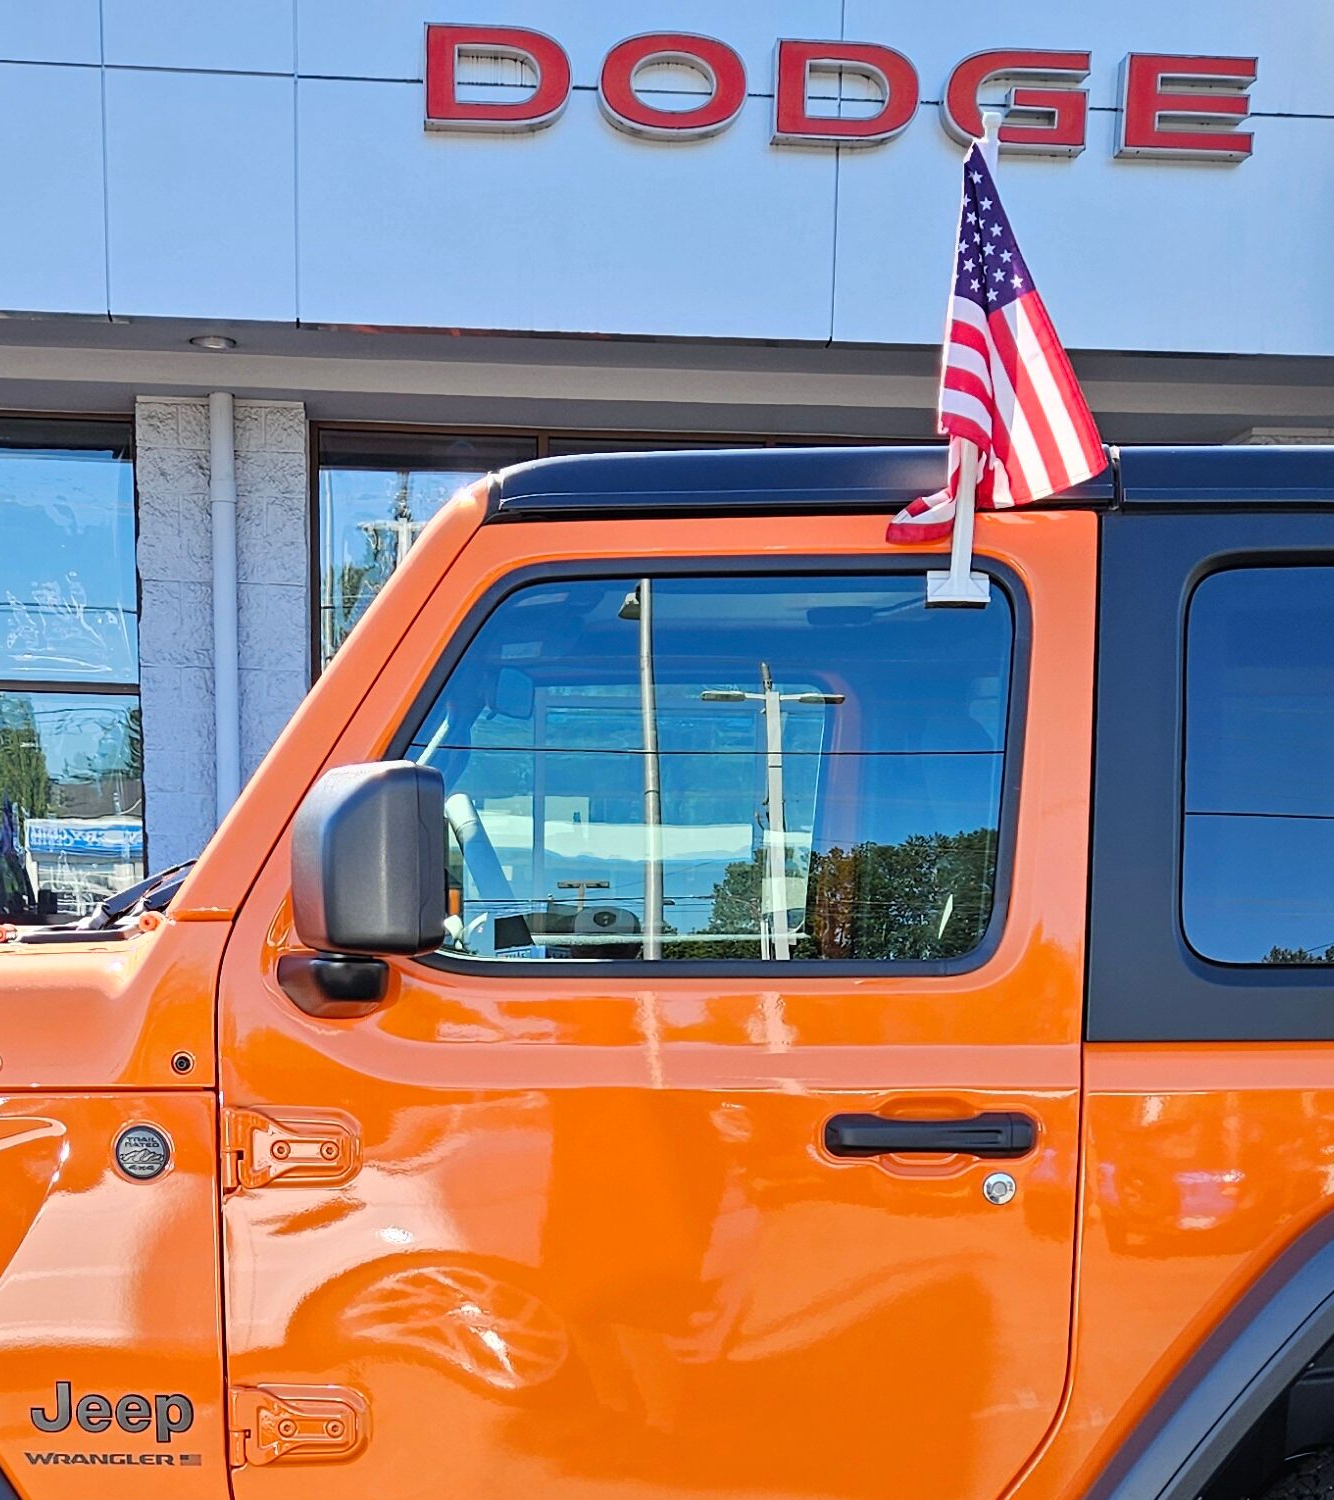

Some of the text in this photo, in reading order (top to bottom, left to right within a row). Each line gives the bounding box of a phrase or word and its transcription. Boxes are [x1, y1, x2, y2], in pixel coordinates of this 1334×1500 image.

[422, 20, 1259, 163] DODGE
[30, 1380, 194, 1443] Jeep
[24, 1451, 175, 1466] WRANGLER
